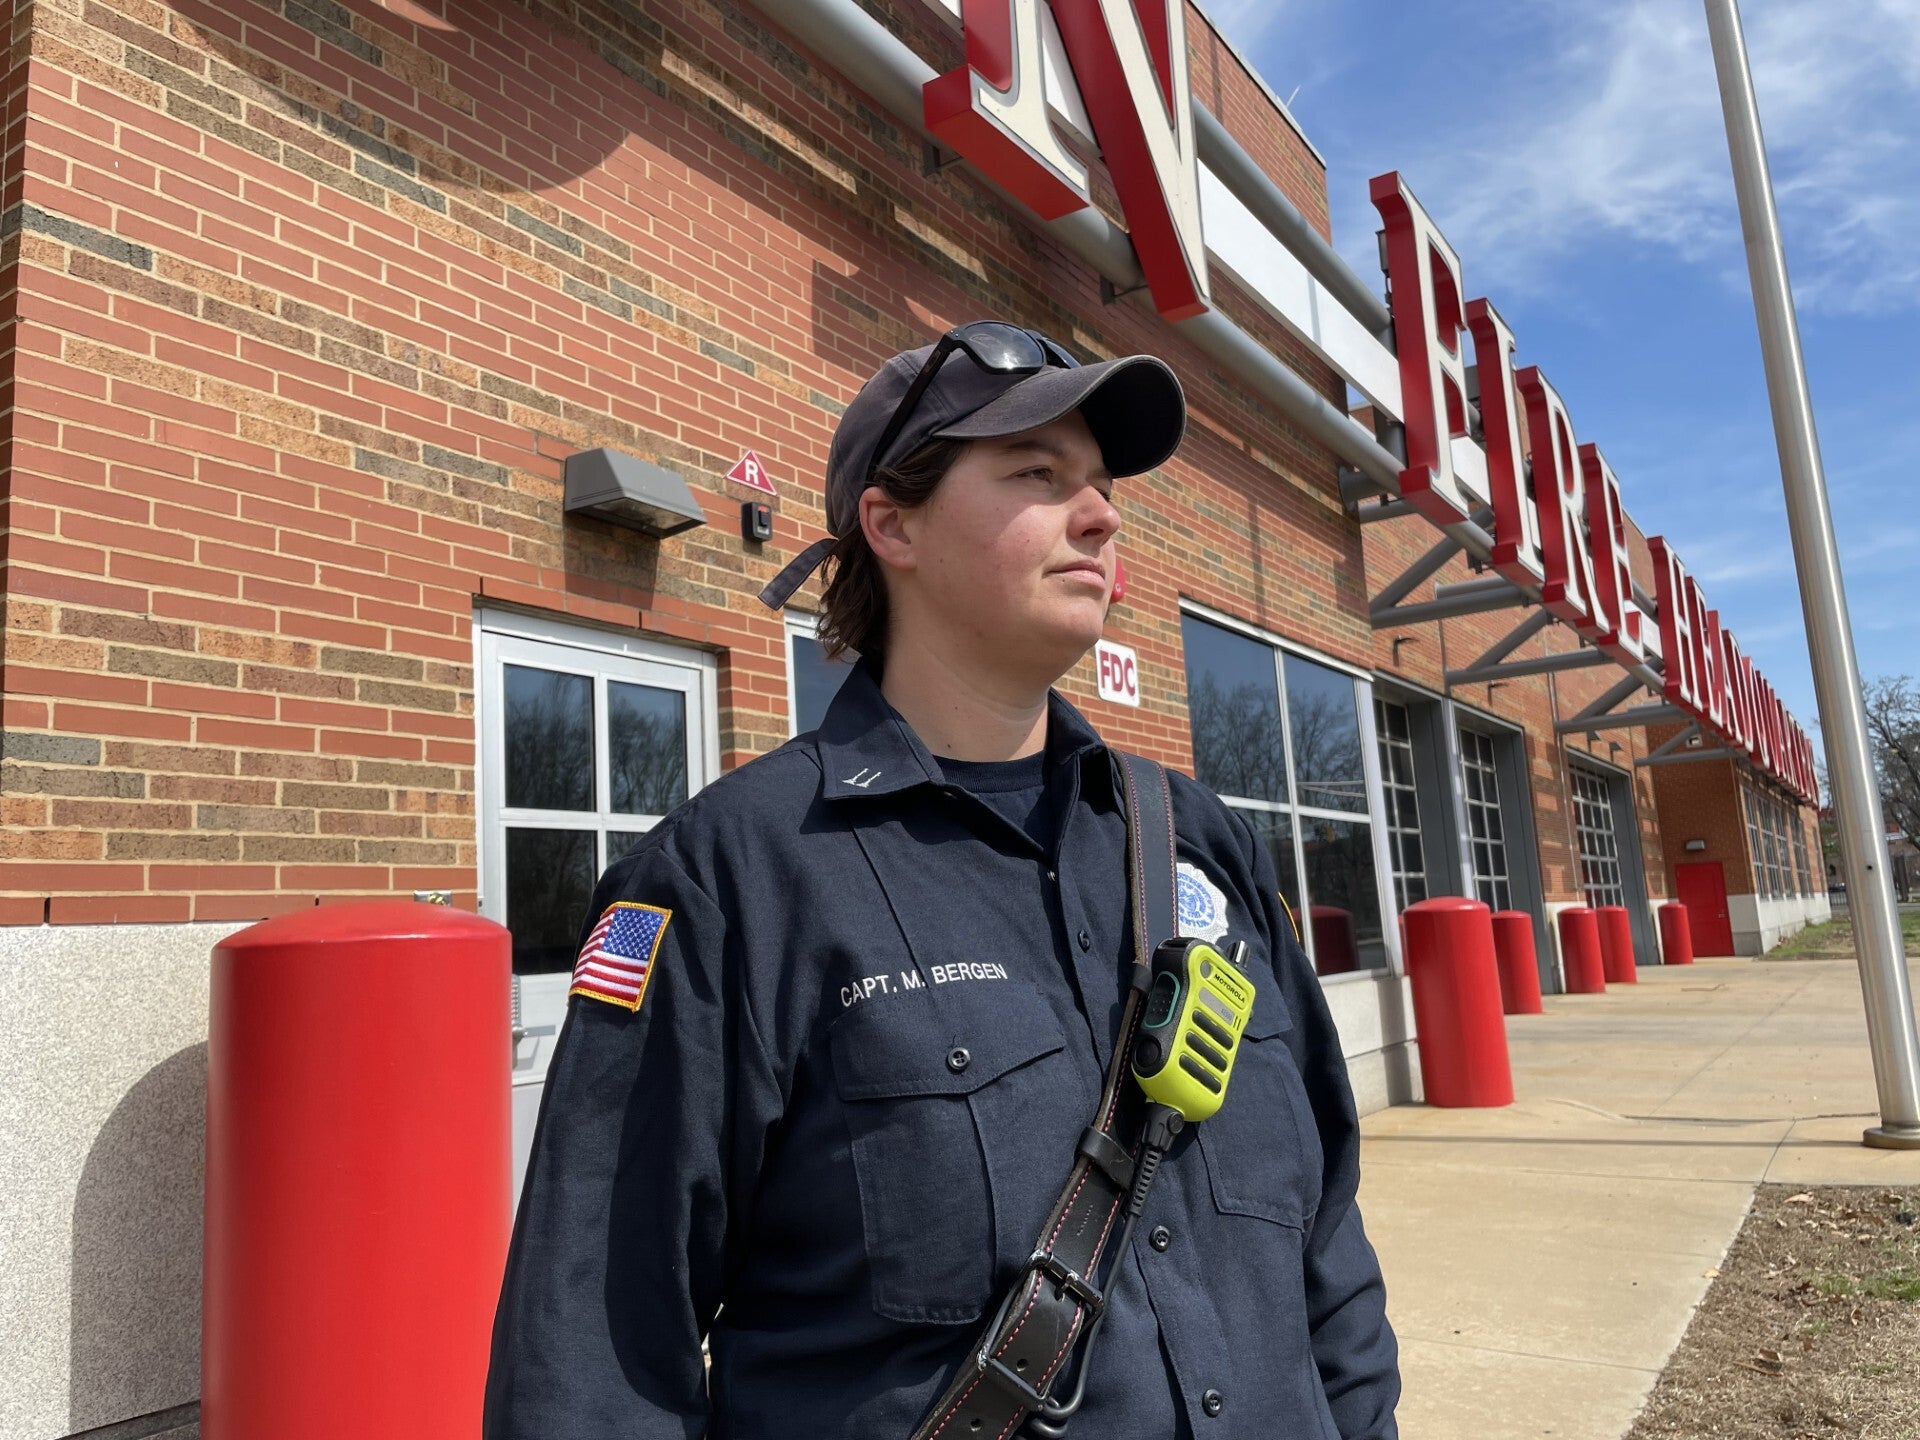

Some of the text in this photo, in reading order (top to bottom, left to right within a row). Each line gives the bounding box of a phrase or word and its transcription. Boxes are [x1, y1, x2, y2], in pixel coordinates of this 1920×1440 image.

[1370, 171, 1644, 666] FIRE
[745, 459, 759, 485] R
[1100, 650, 1136, 697] FDC
[840, 962, 1009, 1008] CAPT. M. BERGEN
[1213, 974, 1246, 1004] MOTOROLA
